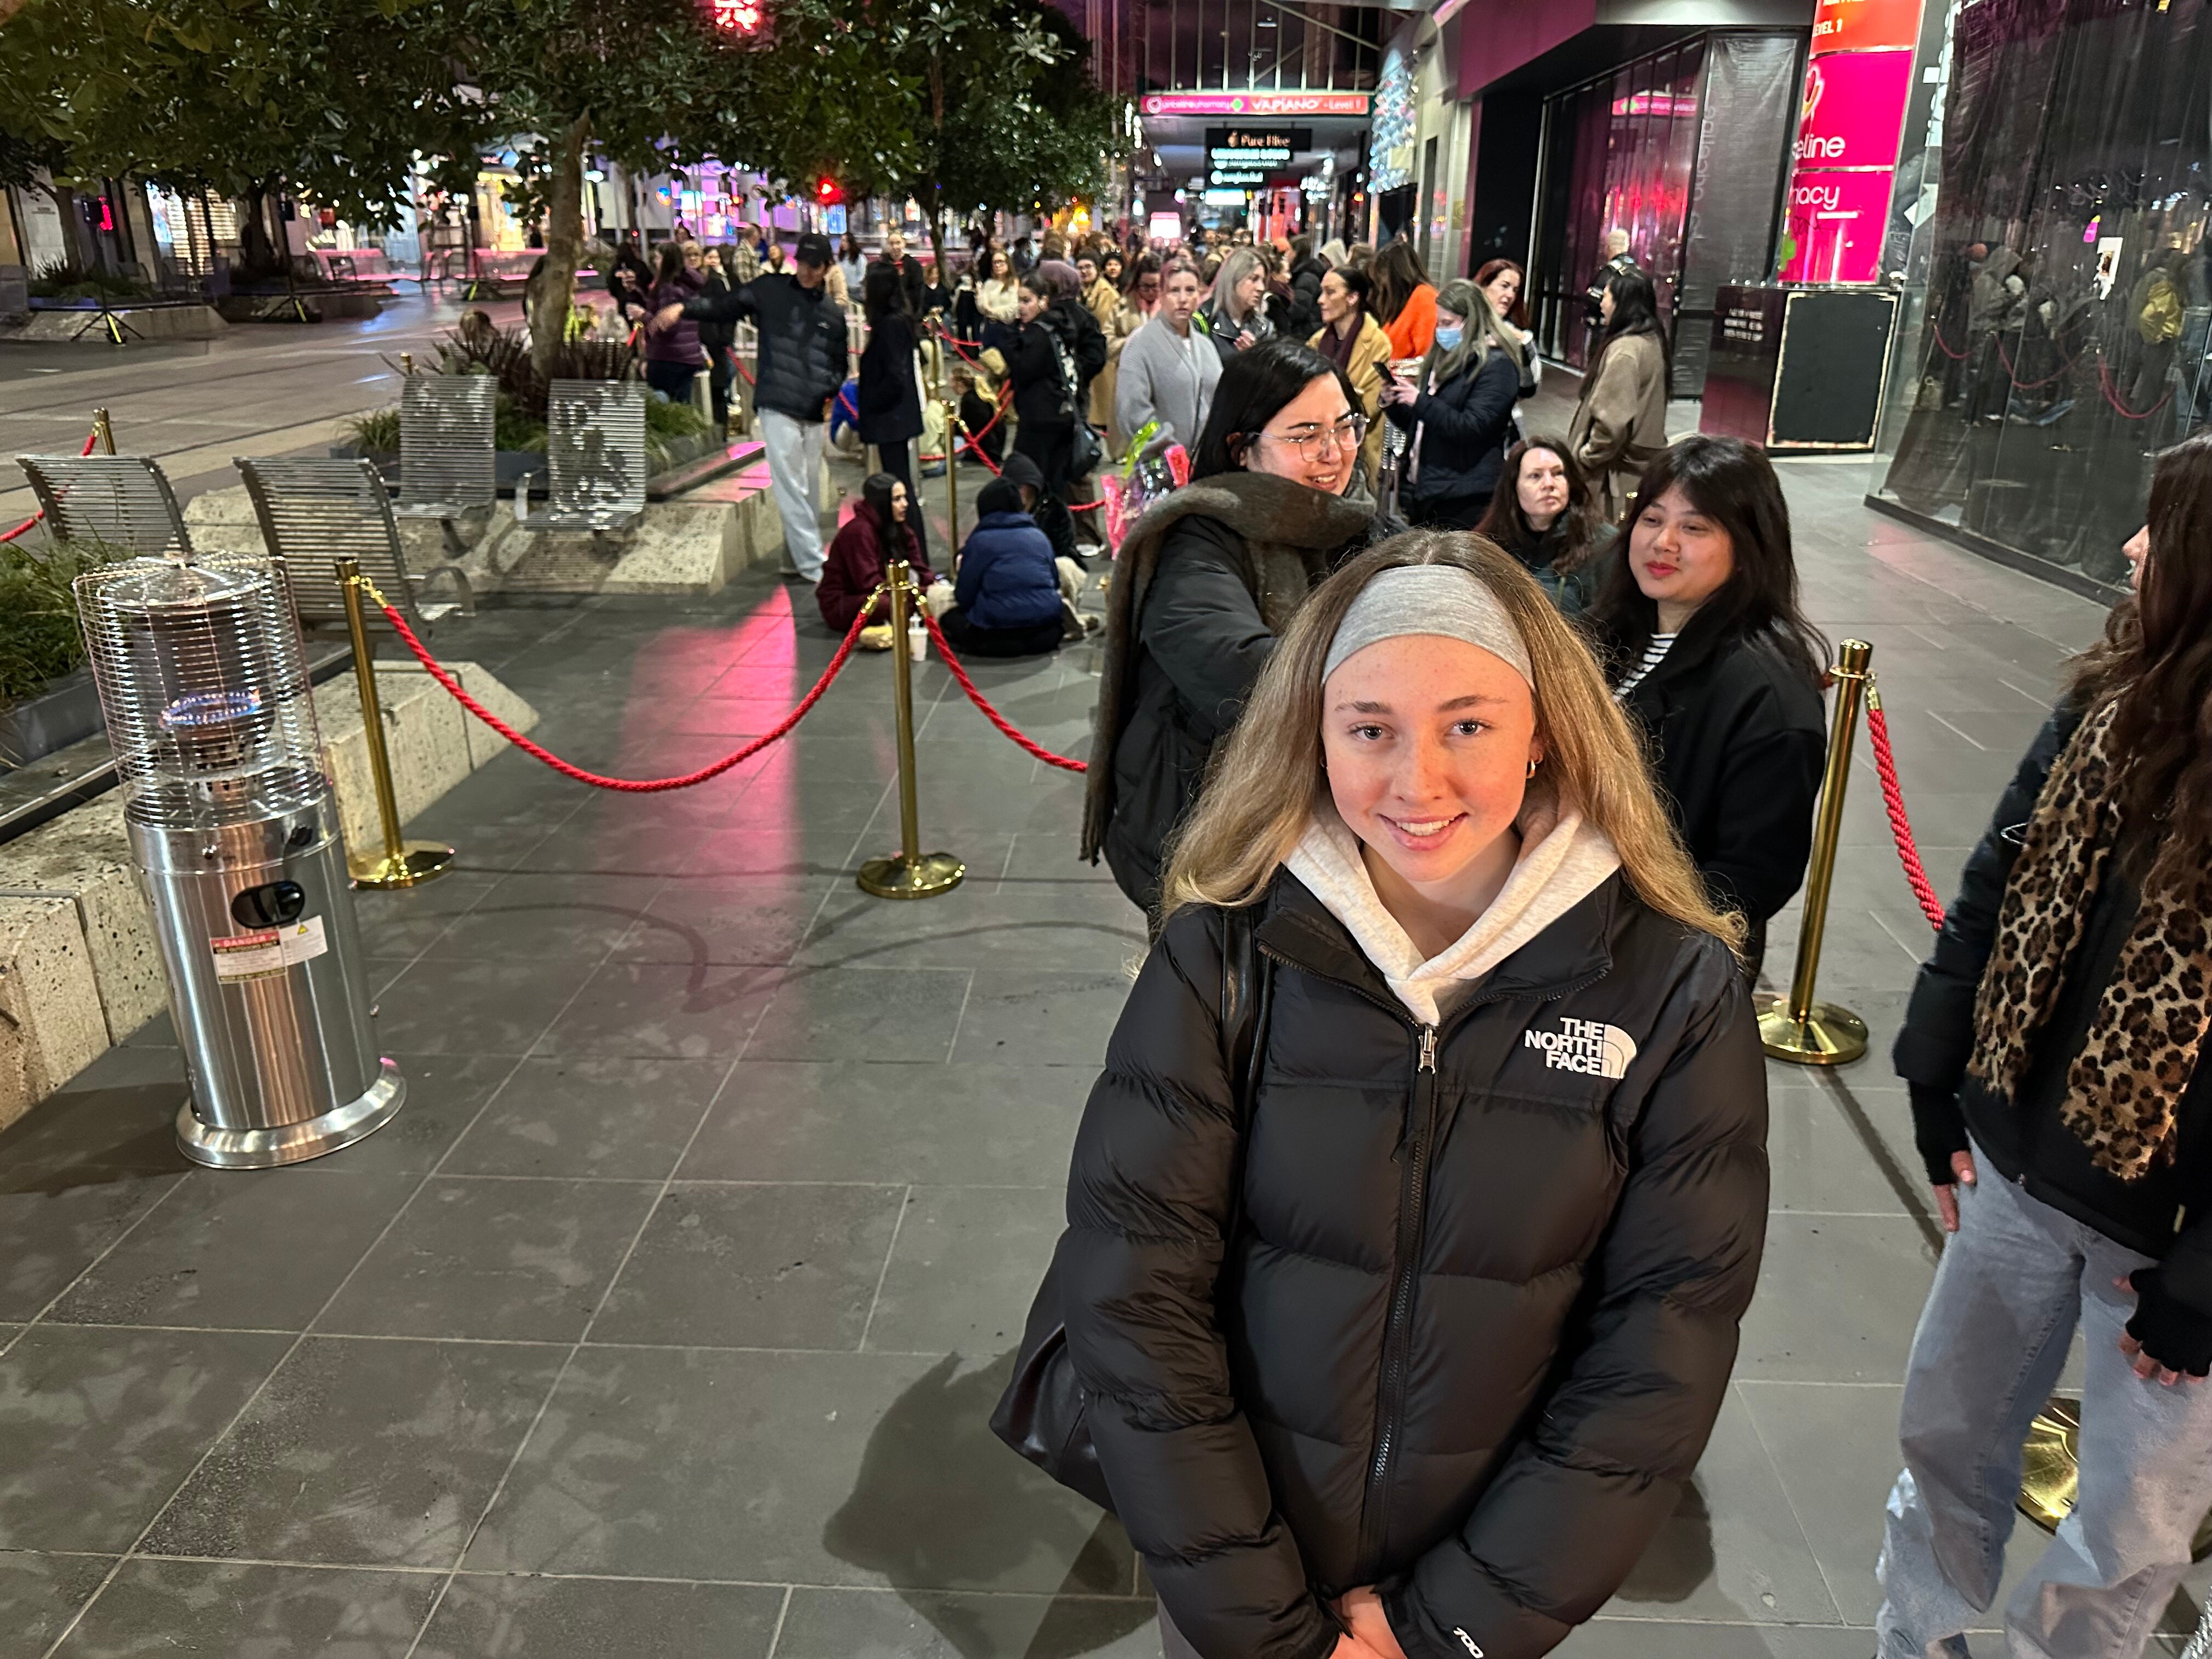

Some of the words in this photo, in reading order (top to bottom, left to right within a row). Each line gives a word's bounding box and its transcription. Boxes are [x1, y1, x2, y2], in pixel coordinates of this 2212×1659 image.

[1812, 20, 1834, 37] EVEL
[1836, 18, 1843, 32] 1
[1560, 1017, 1604, 1041] THE
[1524, 1029, 1602, 1058] NORTH
[1545, 1049, 1602, 1076] FACE
